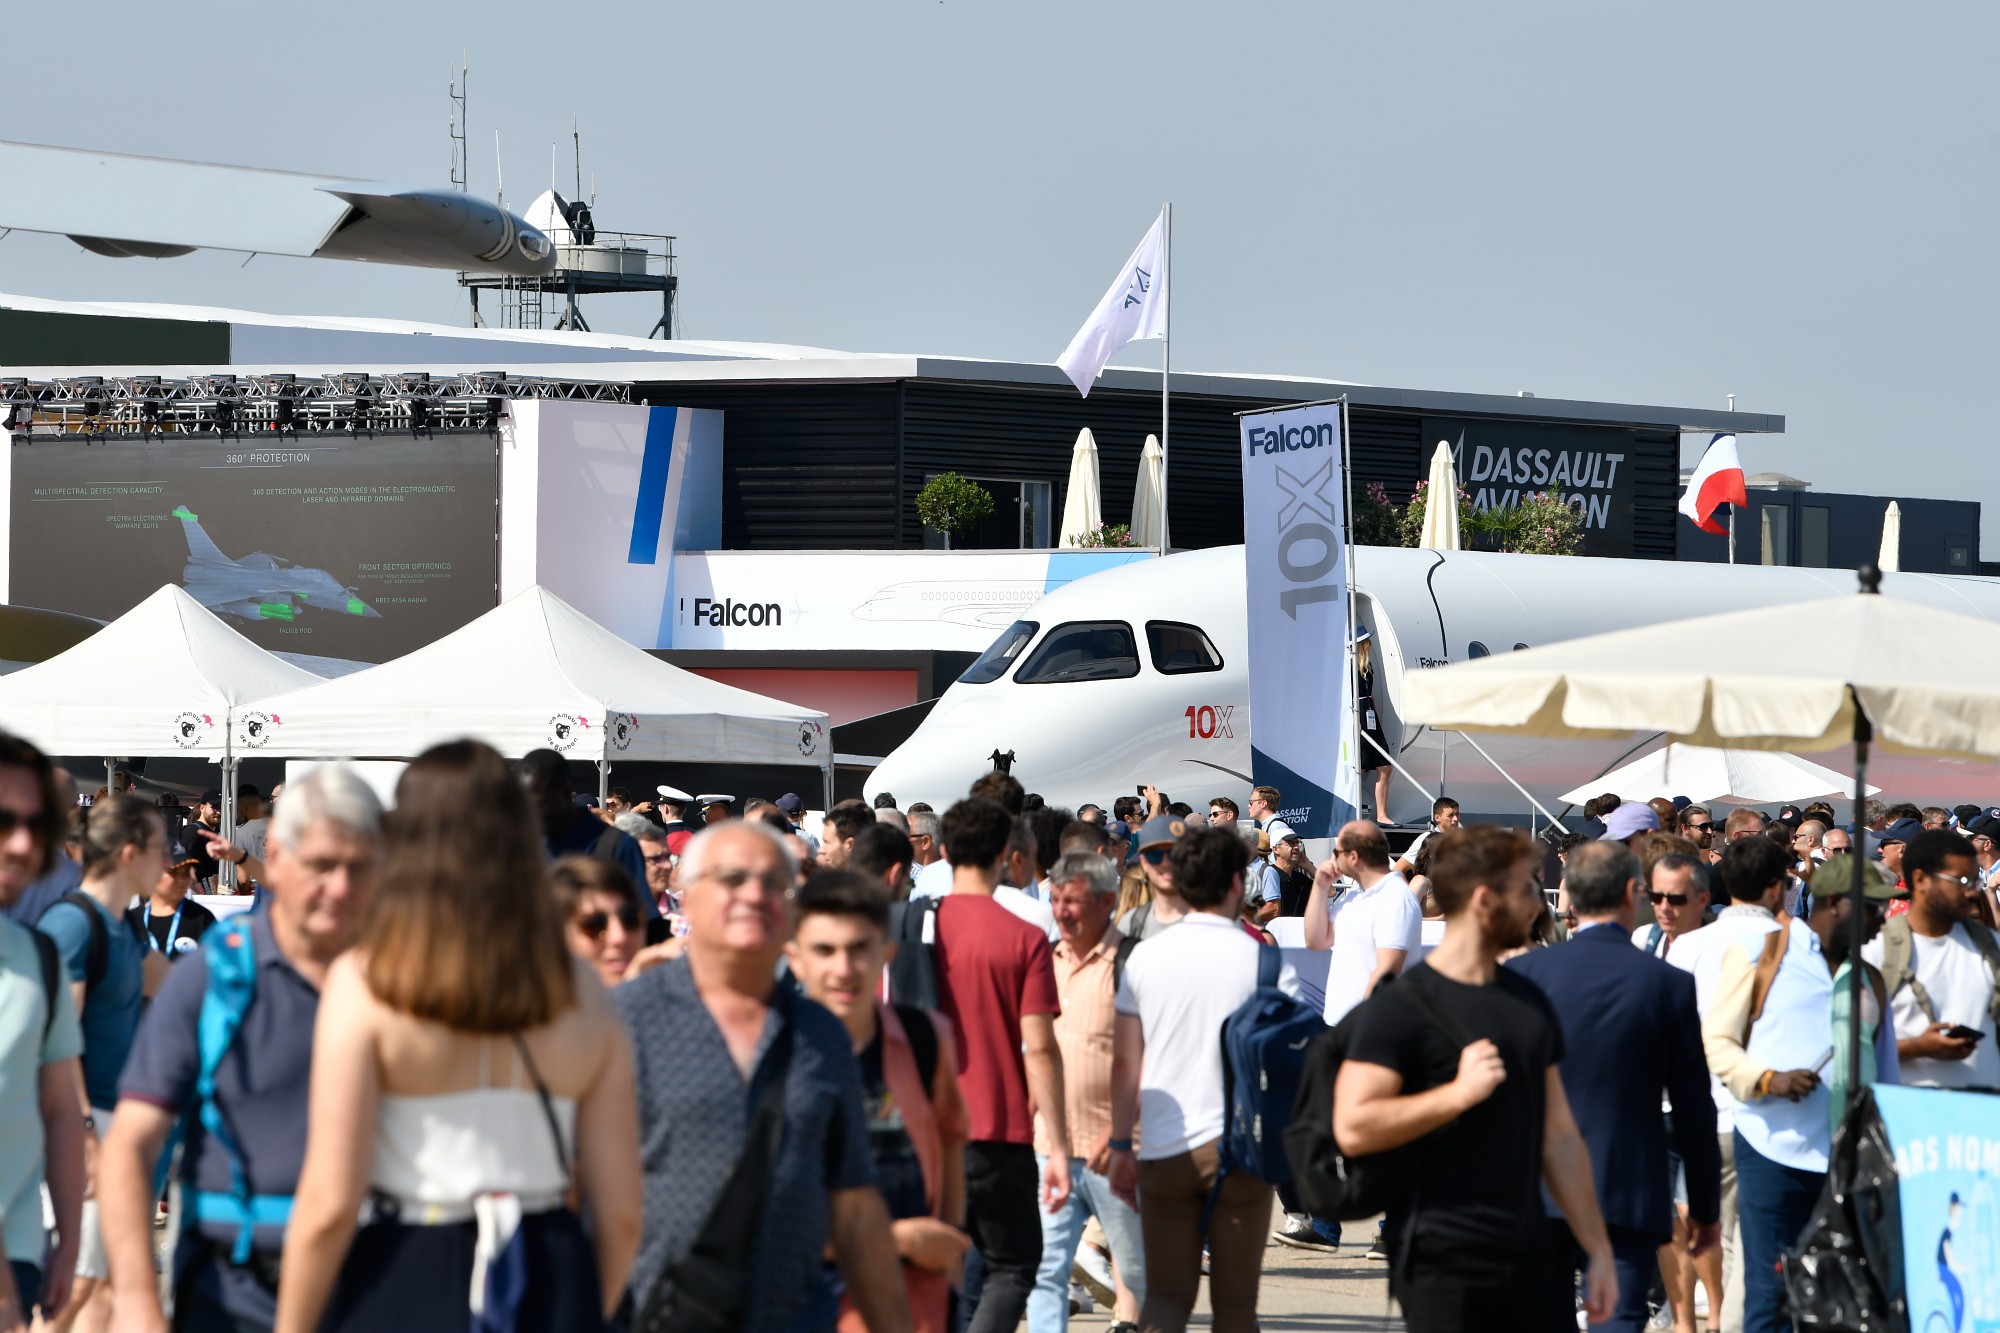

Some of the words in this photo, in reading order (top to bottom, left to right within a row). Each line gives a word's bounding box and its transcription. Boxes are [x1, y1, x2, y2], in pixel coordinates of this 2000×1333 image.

[1249, 423, 1332, 456] Falcon
[226, 454, 246, 463] 360°
[250, 454, 310, 462] PROTECTION
[1470, 445, 1624, 489] DASSAULT
[1275, 456, 1338, 621] 10X
[694, 598, 782, 626] Falcon
[1185, 705, 1234, 739] 10X
